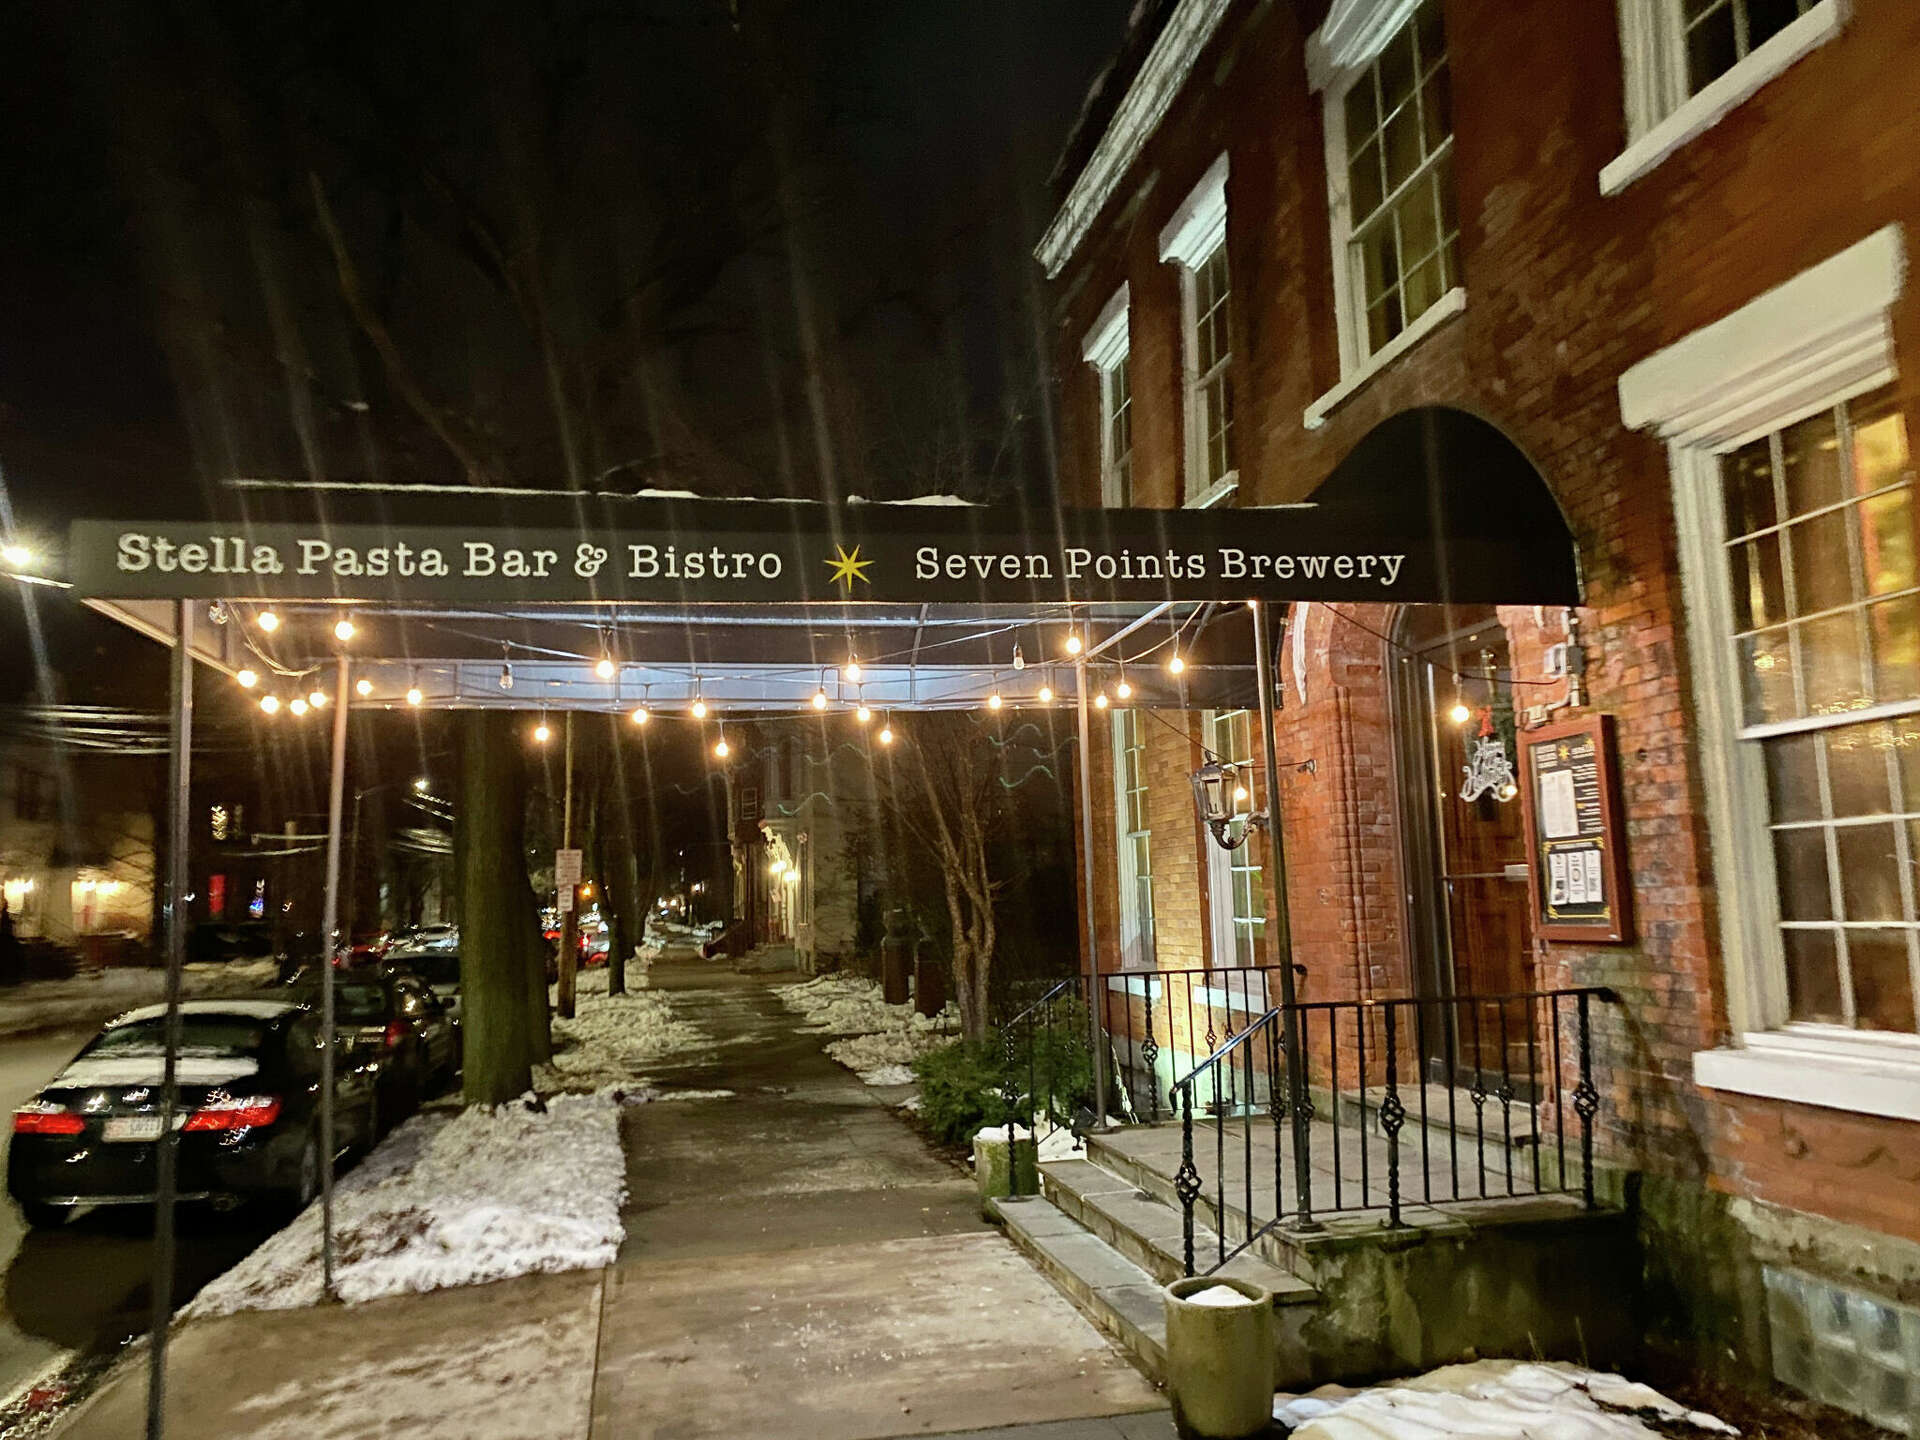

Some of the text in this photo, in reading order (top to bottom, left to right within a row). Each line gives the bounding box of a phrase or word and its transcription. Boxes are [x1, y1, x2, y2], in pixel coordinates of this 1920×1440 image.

[118, 533, 783, 579] Stella Pasta Bar & Bistro
[915, 547, 1406, 587] Seven Points Brewery
